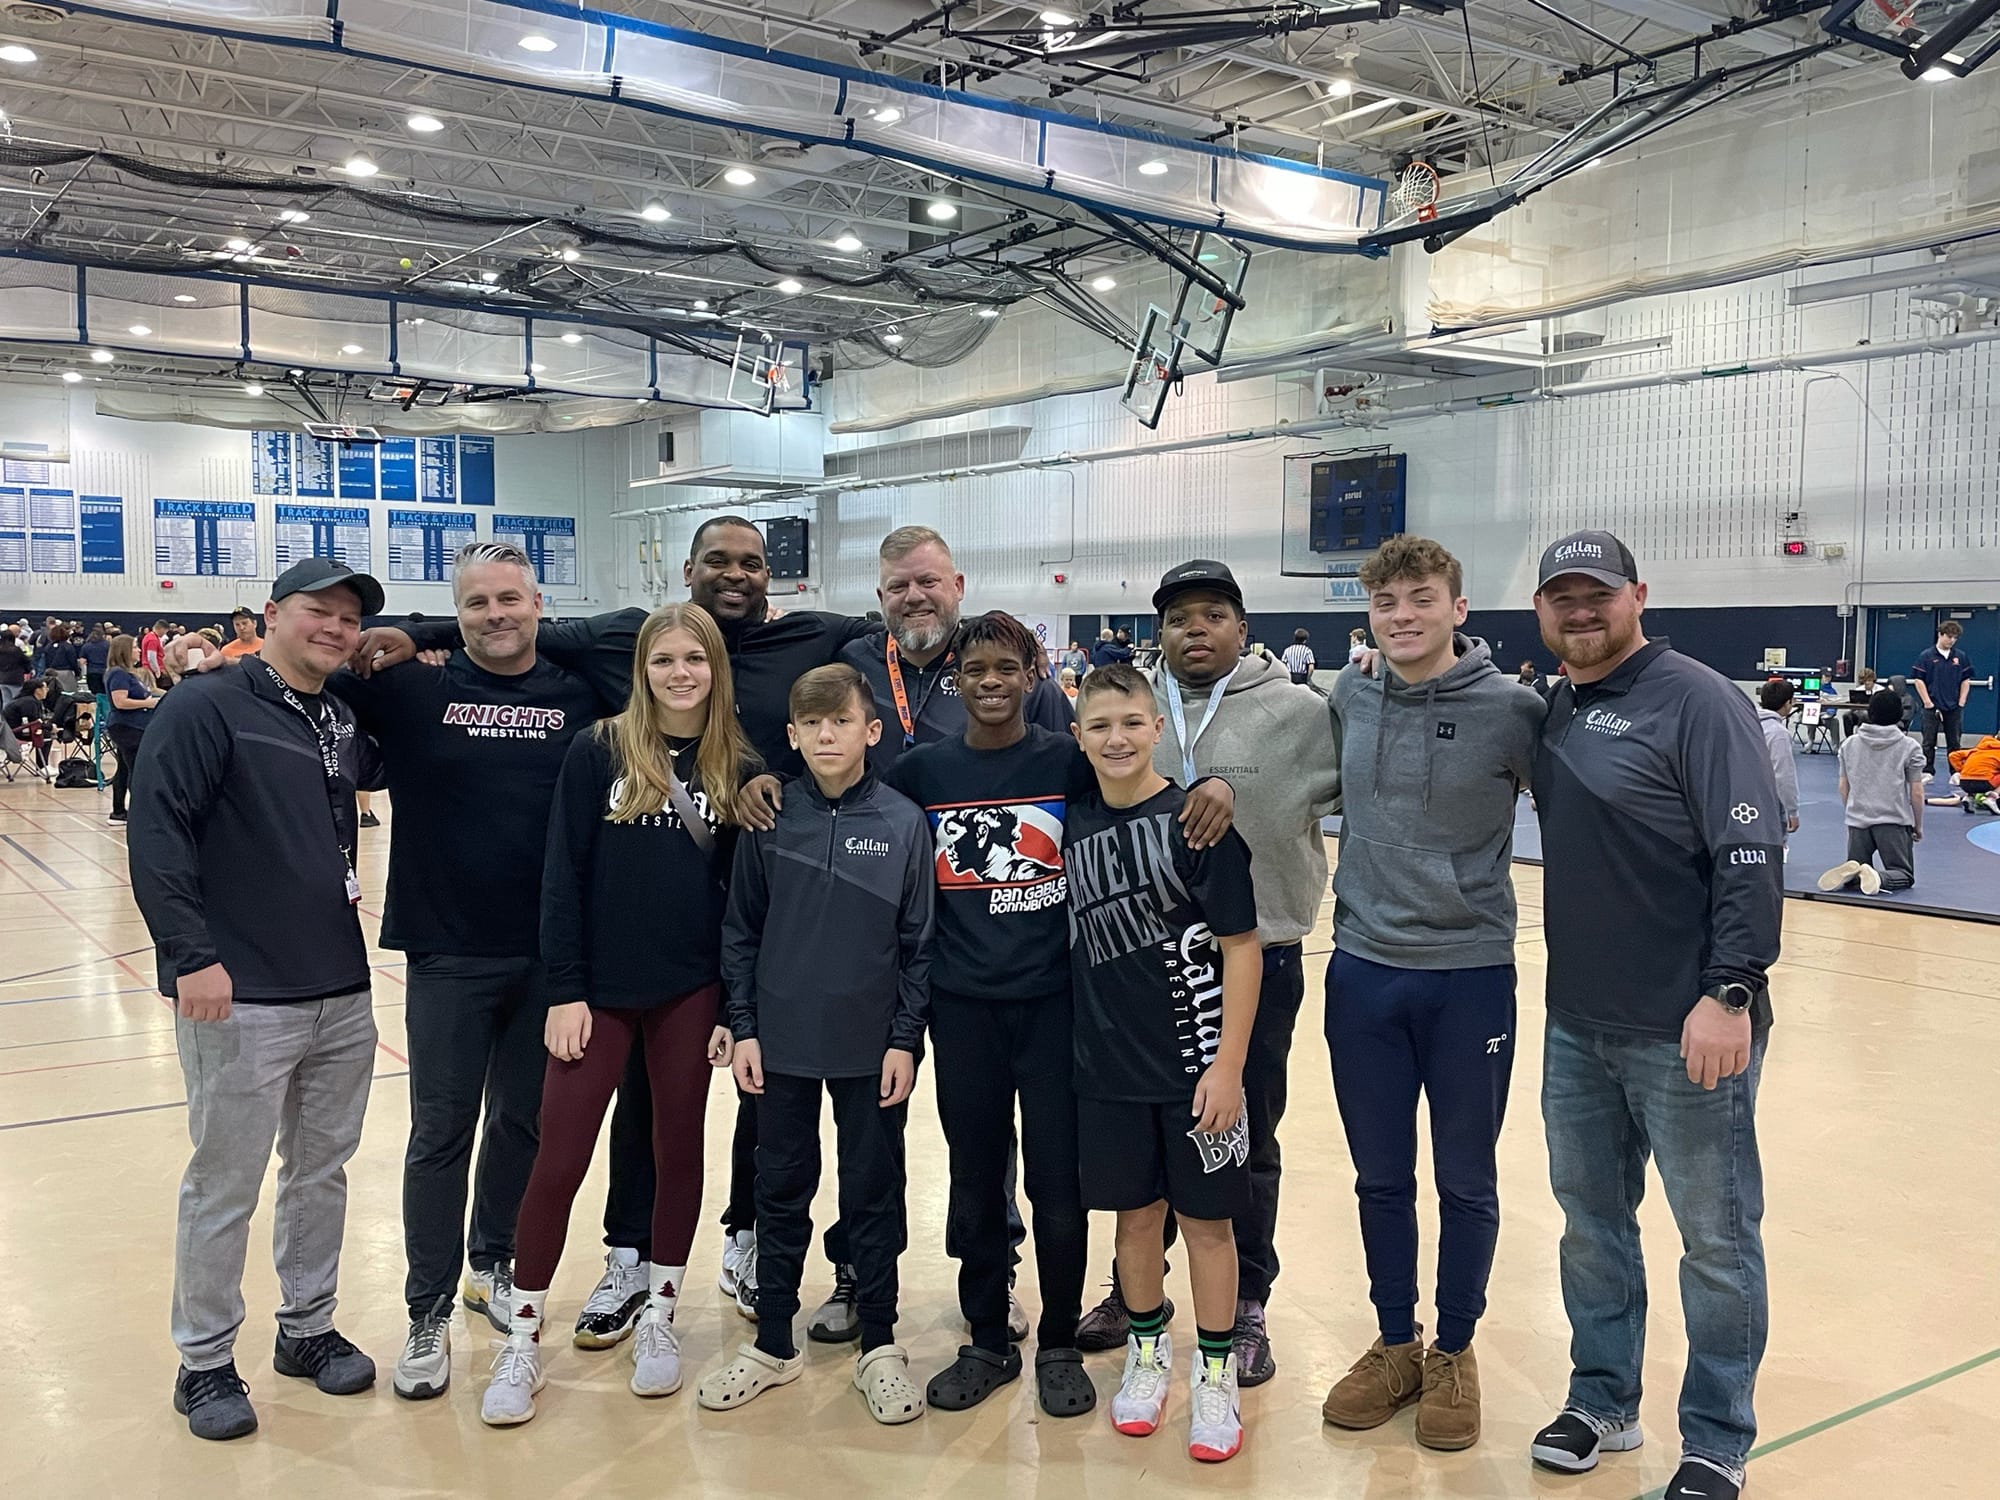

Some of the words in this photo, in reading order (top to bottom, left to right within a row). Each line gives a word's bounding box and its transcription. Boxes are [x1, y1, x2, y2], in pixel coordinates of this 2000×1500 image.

[157, 500, 201, 512] TRACK
[204, 503, 213, 513] &
[216, 504, 253, 514] FIELD
[278, 505, 318, 517] TRACK
[333, 509, 367, 519] FIELD
[390, 511, 428, 522] TRACK
[442, 514, 473, 524] FIELD
[495, 516, 530, 527] TRACK
[543, 518, 573, 529] FIELD
[1555, 541, 1602, 558] Callan
[442, 702, 565, 730] KNIGHTS
[1806, 708, 1817, 717] 12
[1586, 709, 1632, 731] Callan
[467, 727, 547, 739] WRESTLING
[1209, 766, 1260, 774] ESSENTIALS
[845, 836, 889, 852] Callan
[1162, 941, 1199, 1074] WRESTLING
